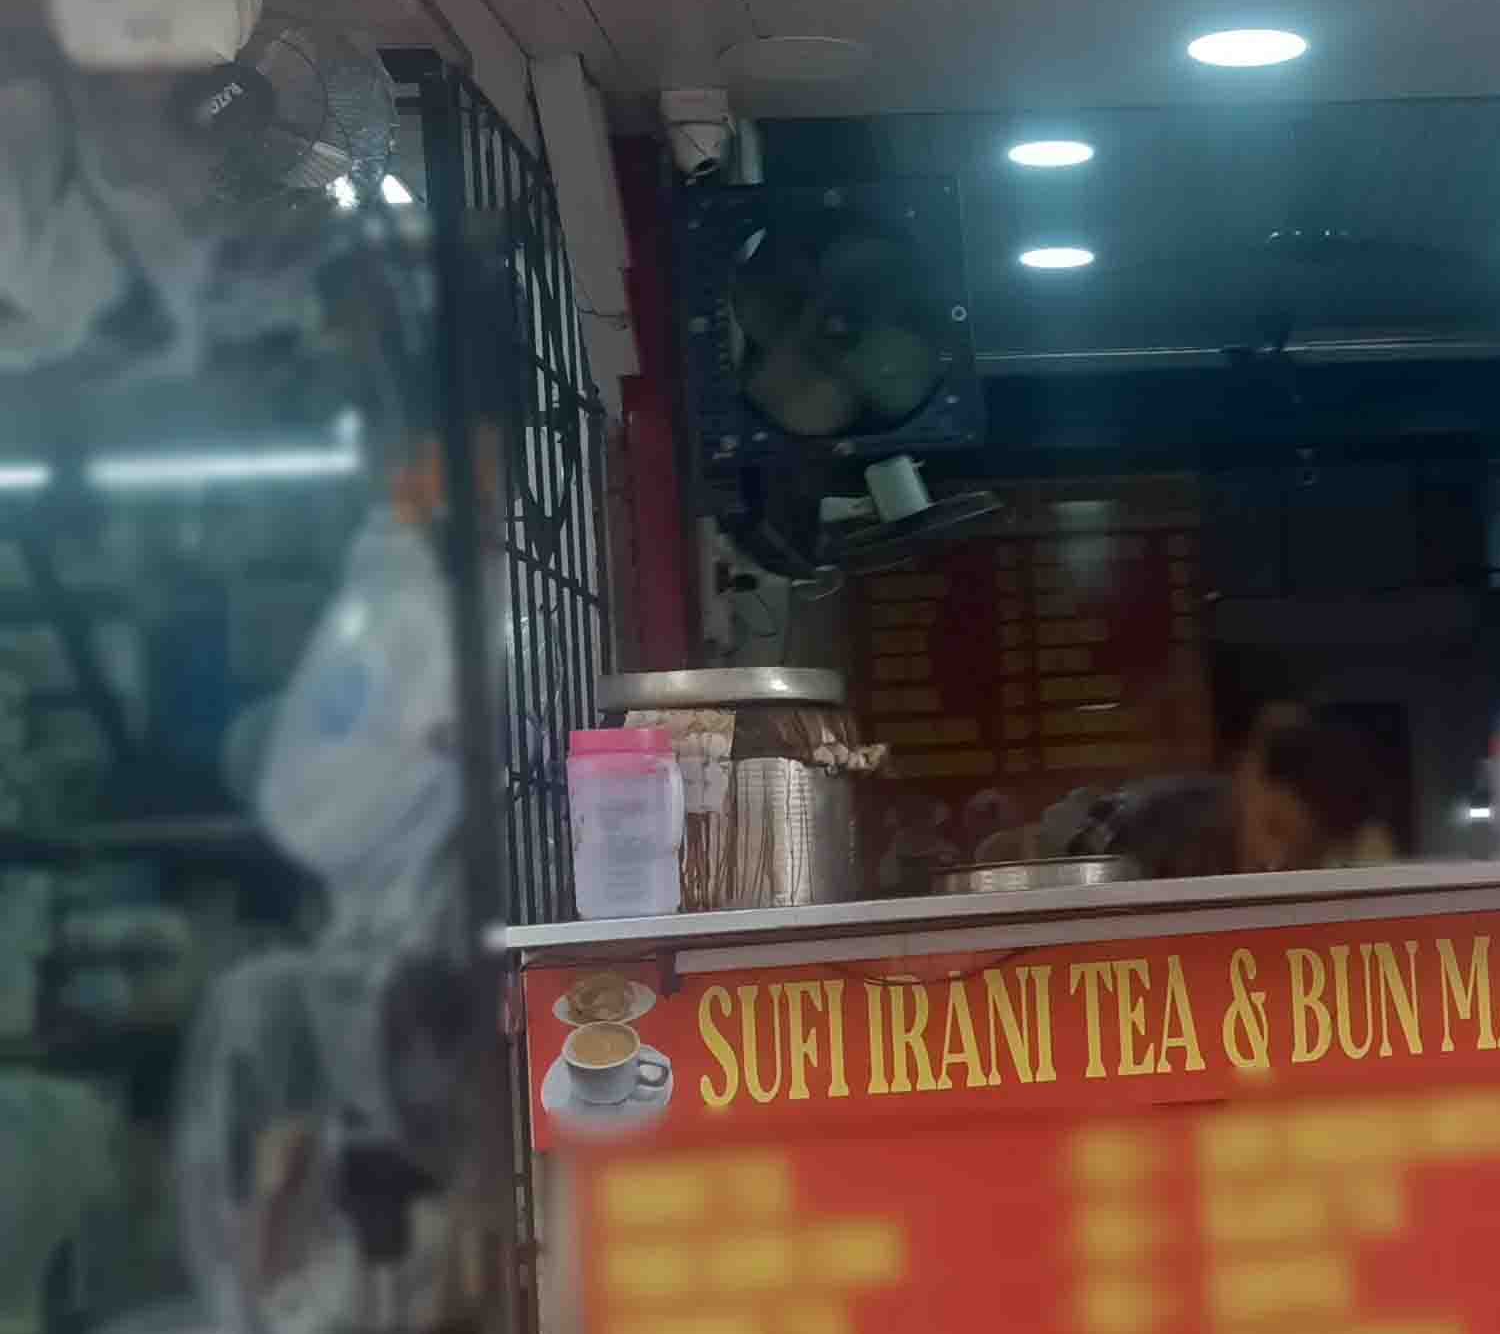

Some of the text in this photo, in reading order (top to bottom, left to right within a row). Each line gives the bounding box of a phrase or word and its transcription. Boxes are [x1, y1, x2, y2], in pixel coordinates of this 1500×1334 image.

[697, 979, 850, 1108] SUFI
[867, 963, 1057, 1095] IRANI
[1069, 954, 1206, 1079] TEA
[1222, 947, 1271, 1075] &
[1285, 939, 1424, 1066] BUN
